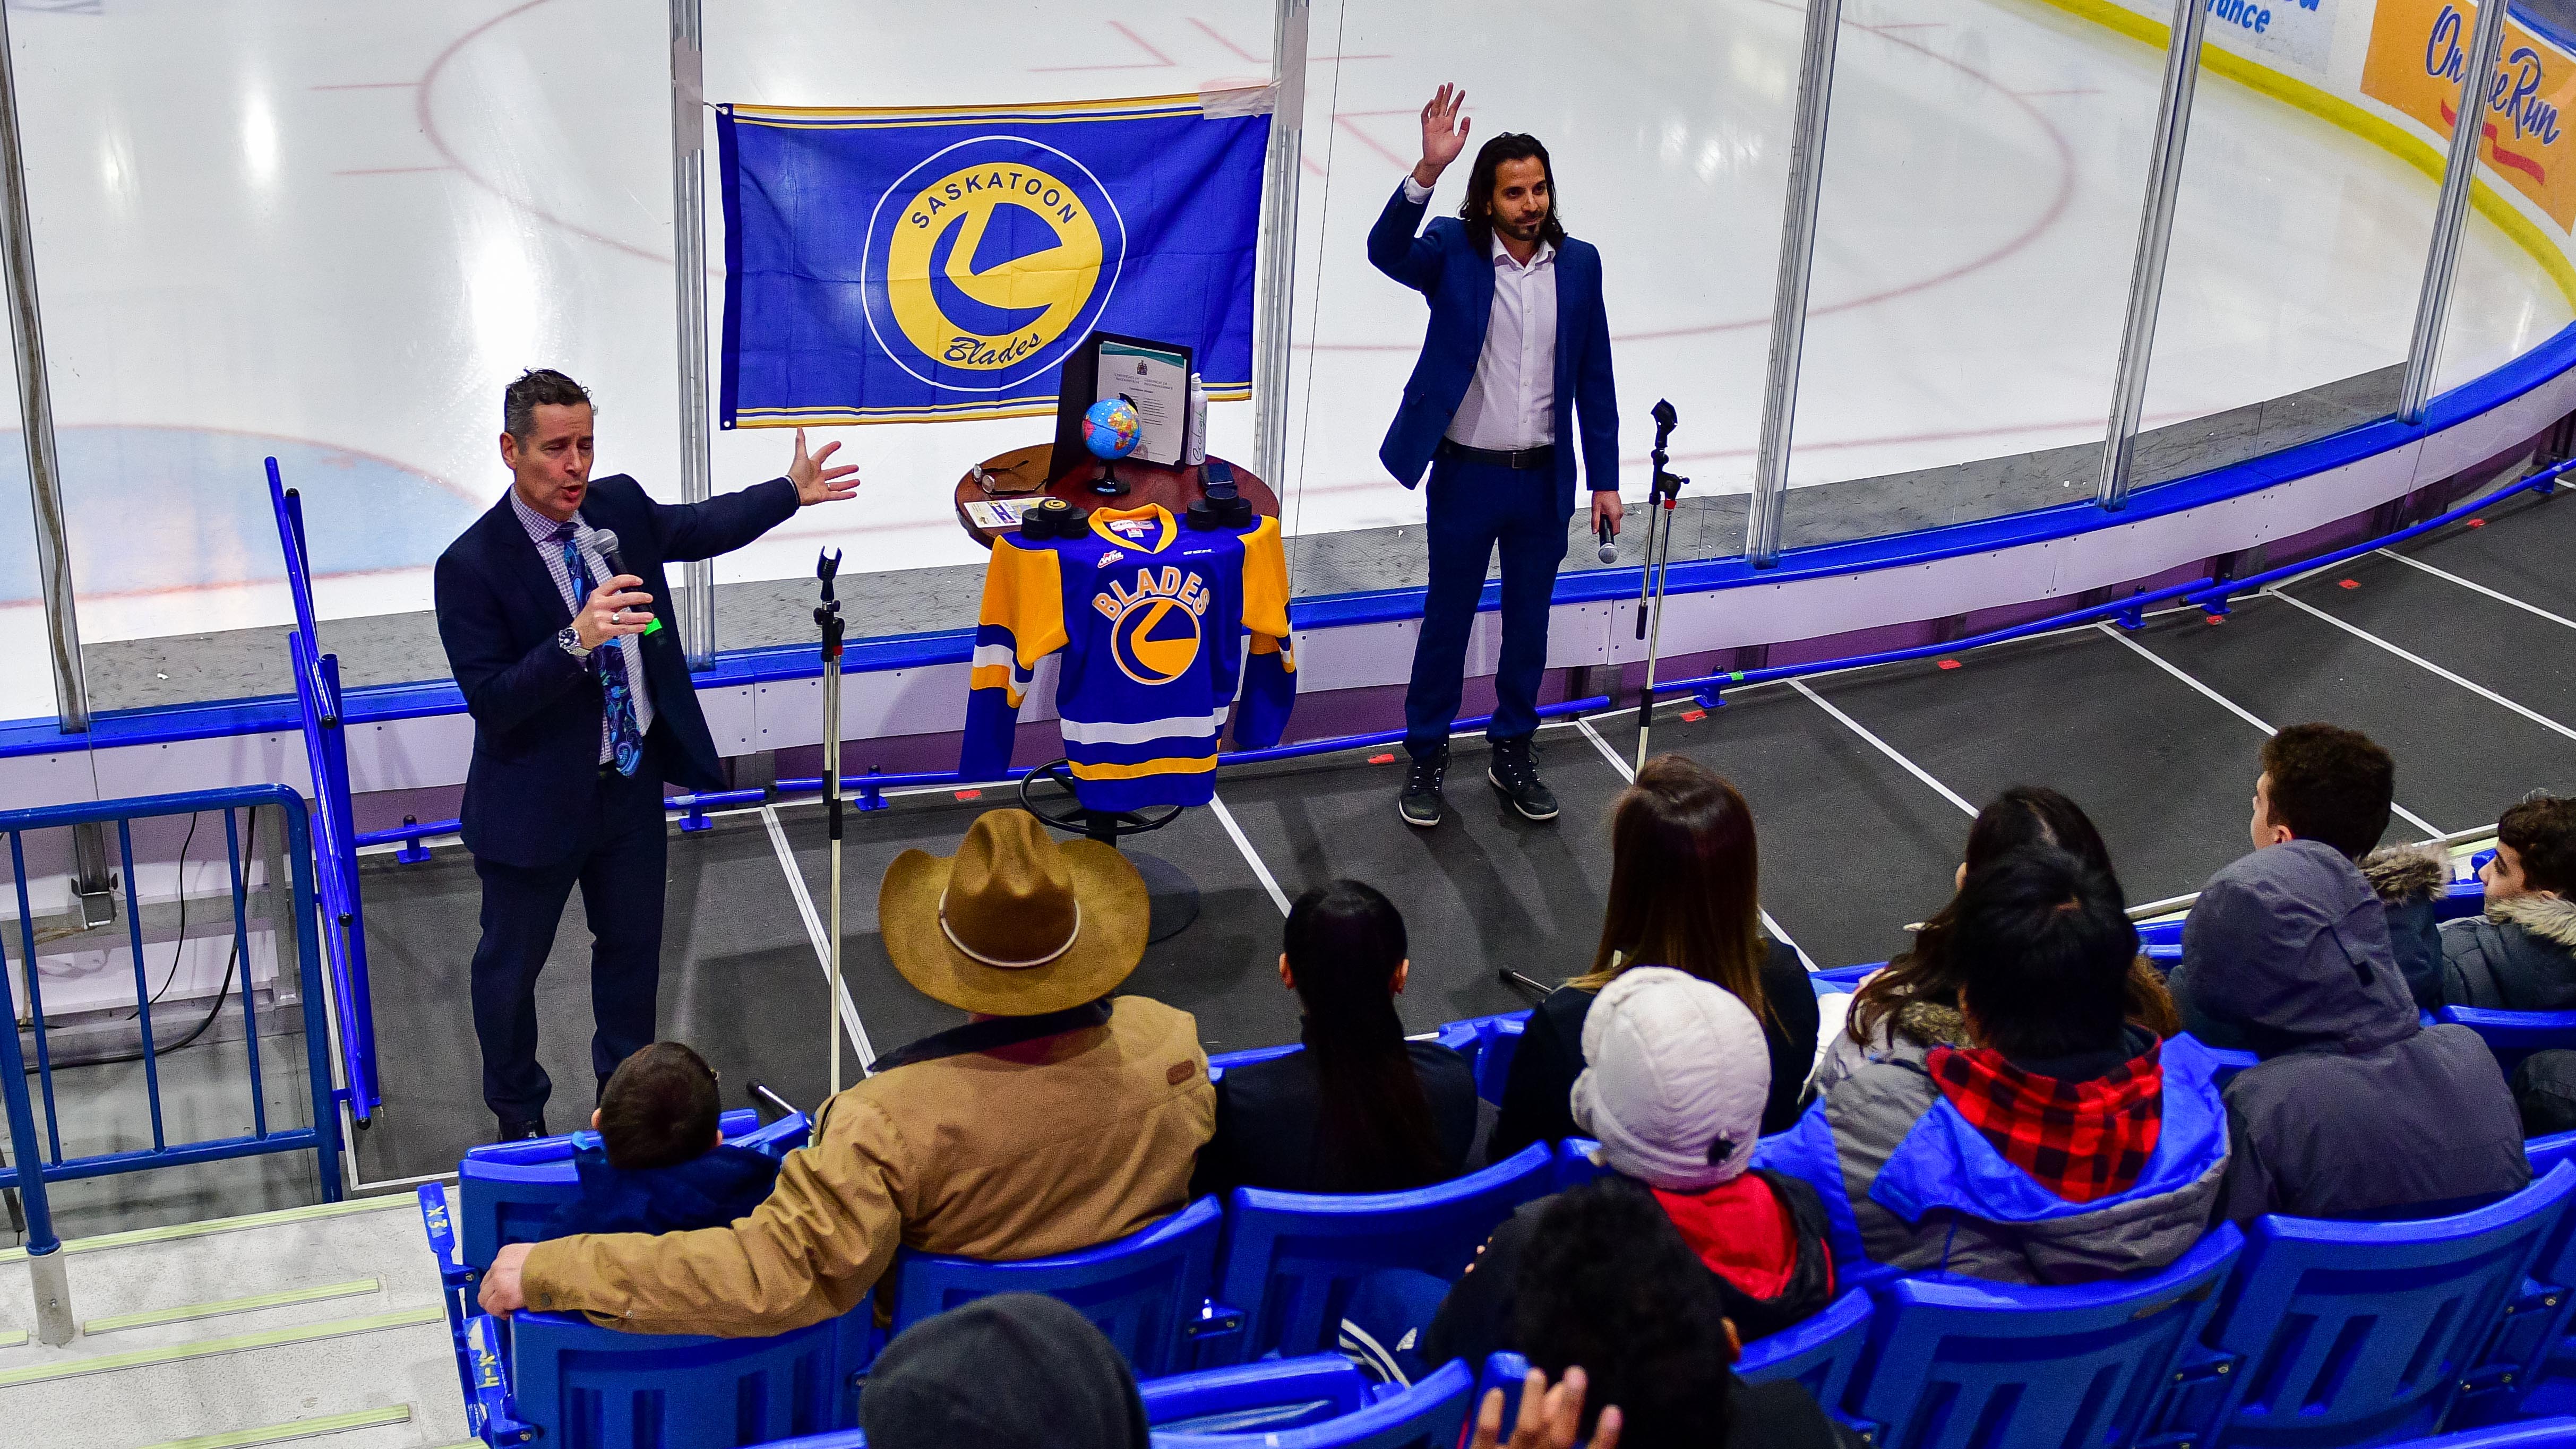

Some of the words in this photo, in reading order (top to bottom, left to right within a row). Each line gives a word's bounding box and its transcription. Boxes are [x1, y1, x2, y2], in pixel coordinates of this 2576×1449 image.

[2426, 5, 2465, 84] On
[2505, 47, 2562, 145] Run
[911, 171, 1077, 229] SASKATOON
[943, 332, 1042, 365] Blades
[1098, 551, 1124, 566] WHL
[1092, 565, 1210, 622] BLADES
